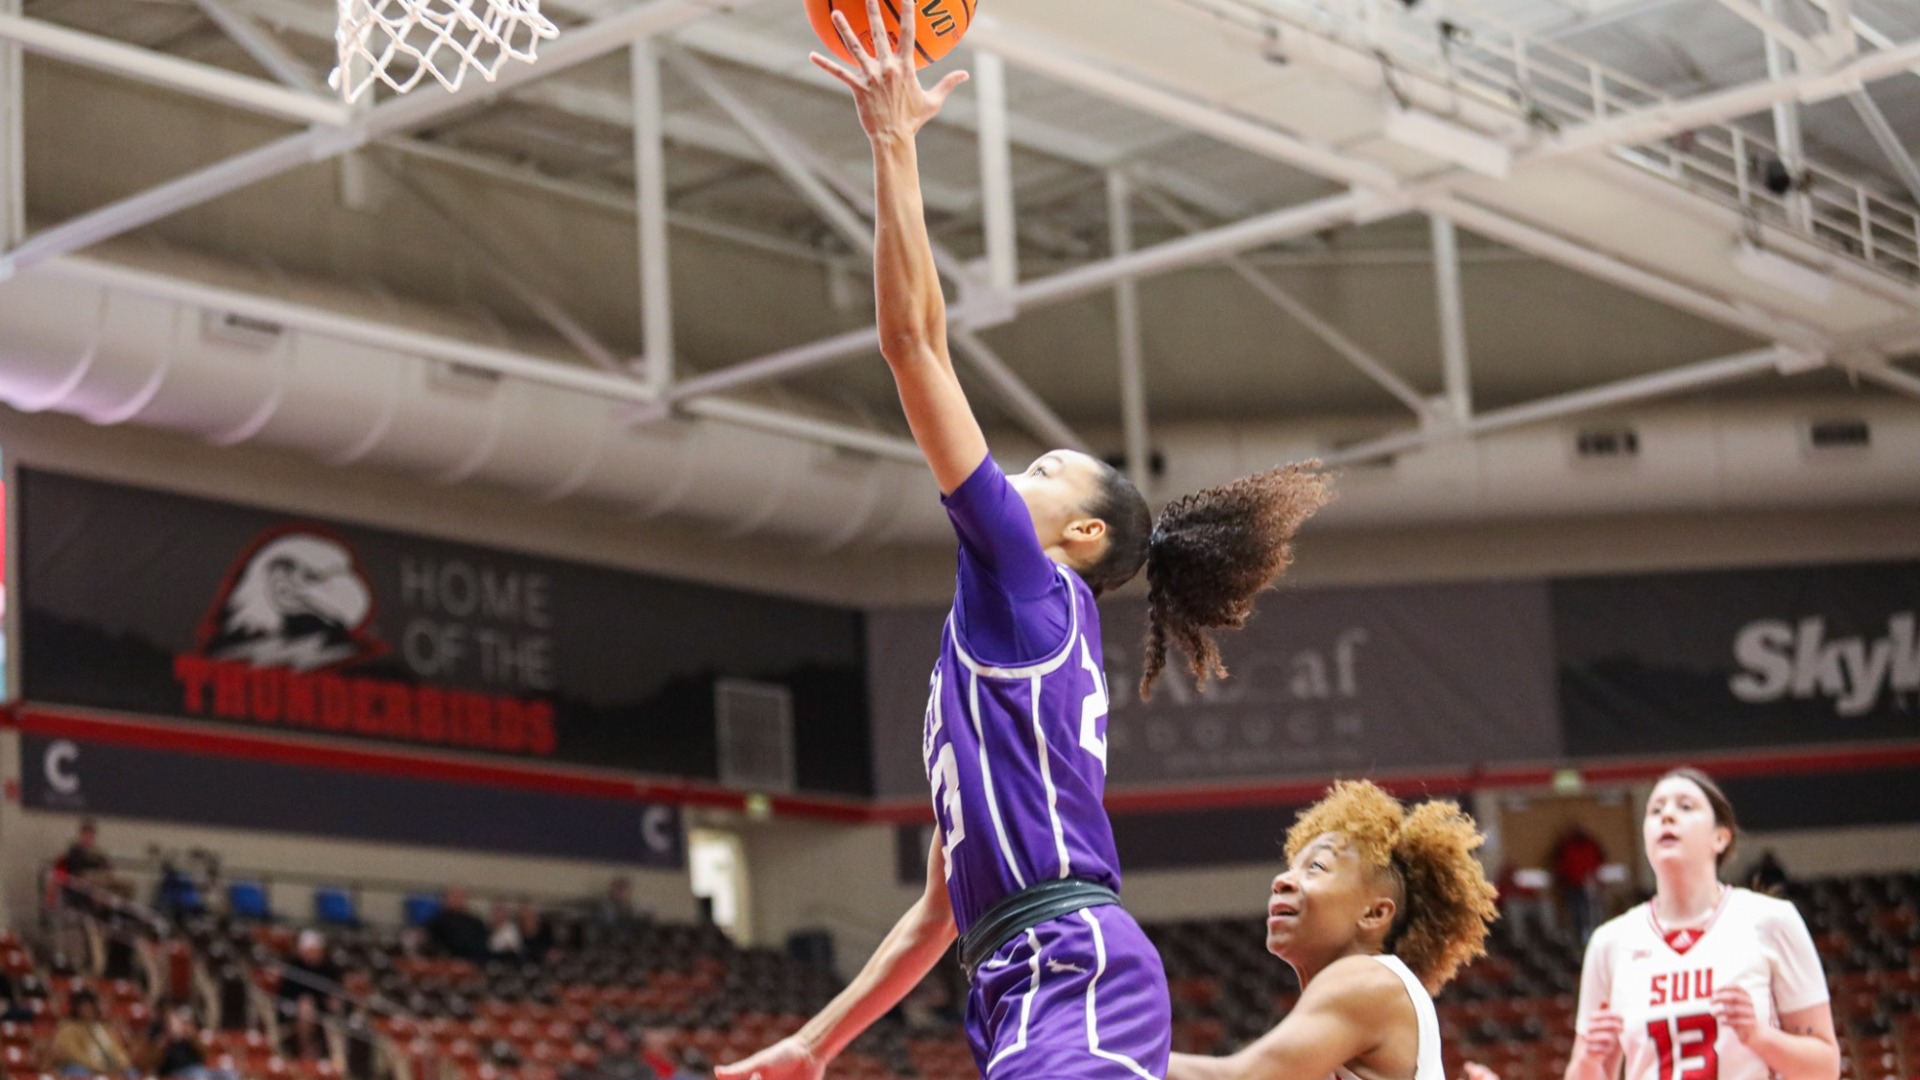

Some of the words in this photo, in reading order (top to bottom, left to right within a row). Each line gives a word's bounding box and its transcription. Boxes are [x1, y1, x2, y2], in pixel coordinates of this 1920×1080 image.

[401, 556, 553, 629] HOME
[403, 617, 466, 676] OF
[473, 628, 554, 688] THE
[174, 651, 557, 755] THUNDERBIRDS
[44, 740, 79, 795] C
[642, 804, 672, 852] C
[1650, 967, 1713, 1006] SUU
[1647, 1013, 1718, 1080] 13
